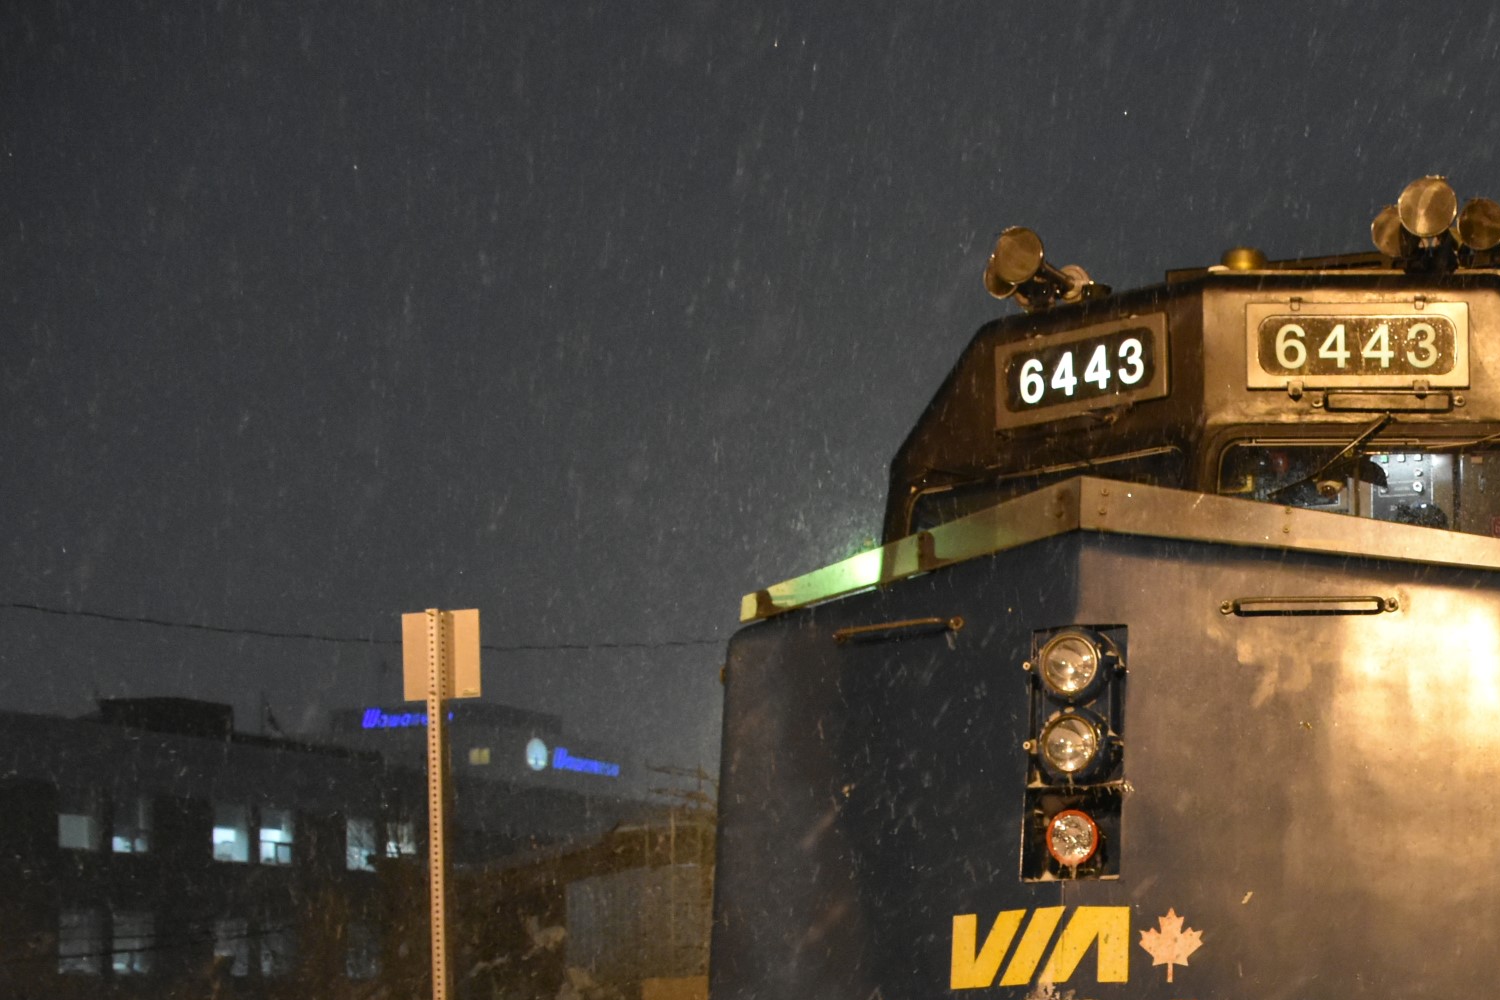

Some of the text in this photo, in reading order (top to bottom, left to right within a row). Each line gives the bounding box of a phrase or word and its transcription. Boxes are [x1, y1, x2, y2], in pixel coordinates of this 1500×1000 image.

[1019, 338, 1145, 404] 6443
[1274, 323, 1439, 369] 6443
[951, 905, 1131, 990] VIA
